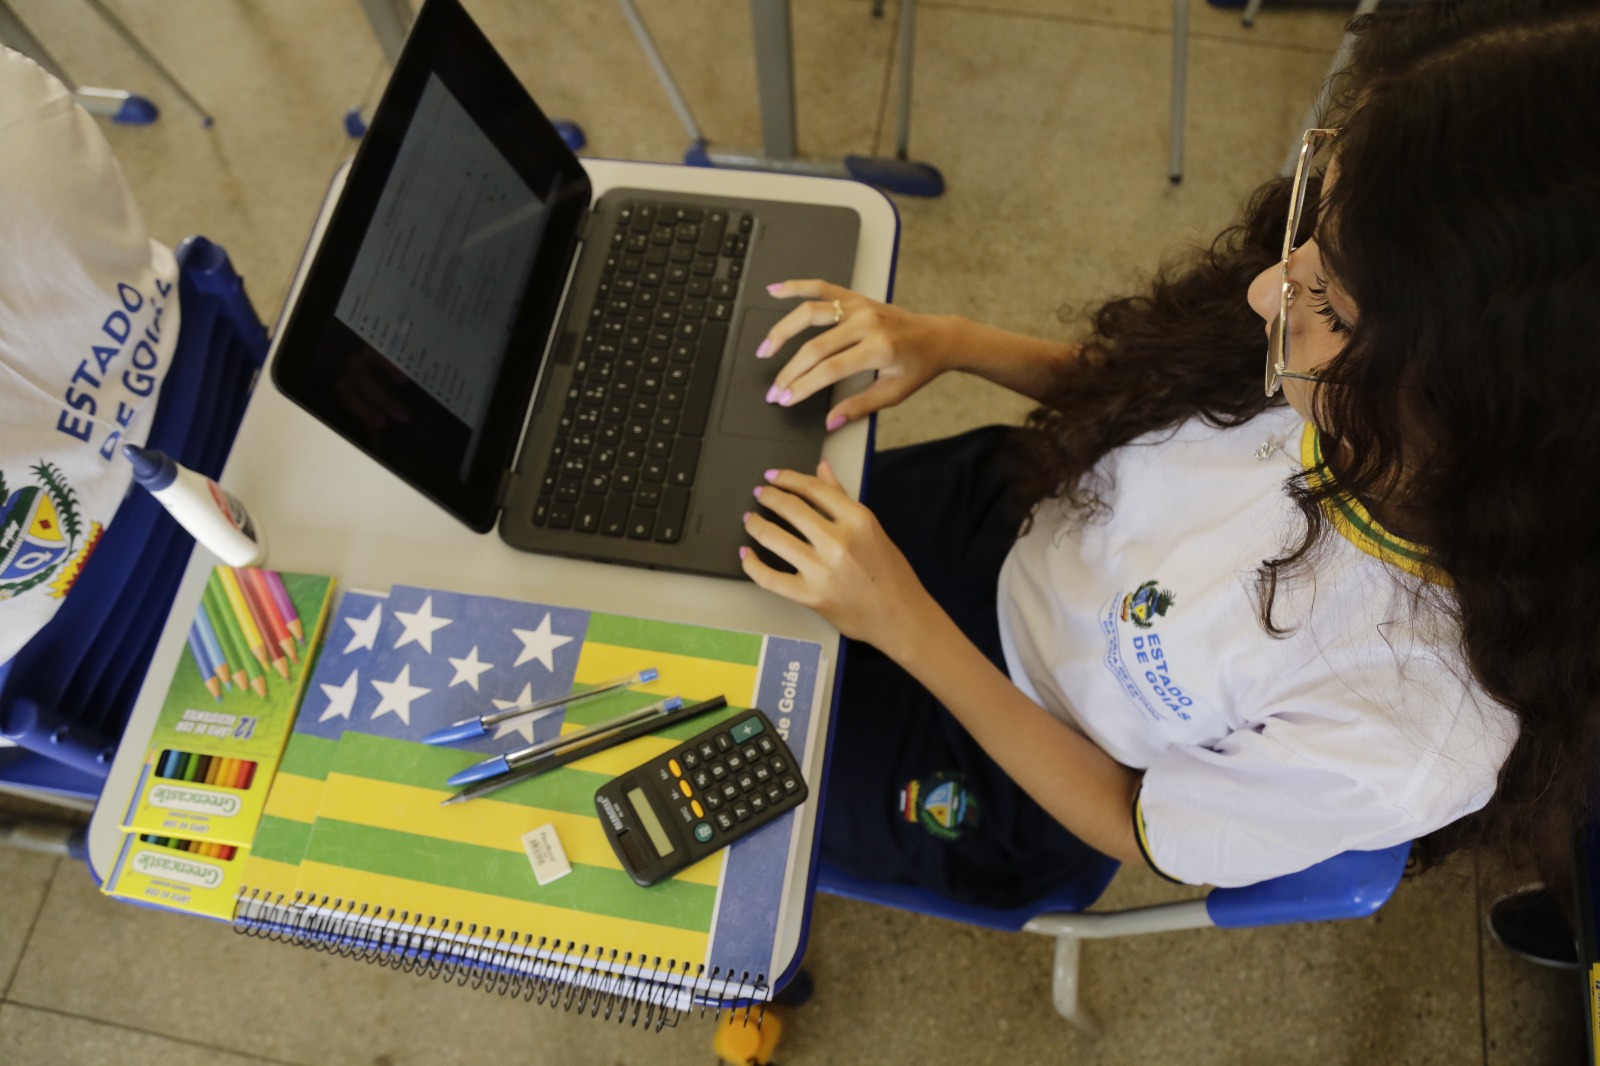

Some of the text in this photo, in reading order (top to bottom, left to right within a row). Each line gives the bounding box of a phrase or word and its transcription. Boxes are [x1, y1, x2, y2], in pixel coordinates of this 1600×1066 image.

[56, 282, 143, 442] ESTADO
[1132, 636, 1149, 664] DE
[1148, 634, 1193, 706] ESTADO
[778, 661, 800, 713] Goiás
[234, 717, 256, 738] 12
[154, 786, 237, 813] Greencastle
[680, 806, 692, 822] MRC
[718, 814, 730, 826] OFF
[138, 854, 219, 884] Greencastle
